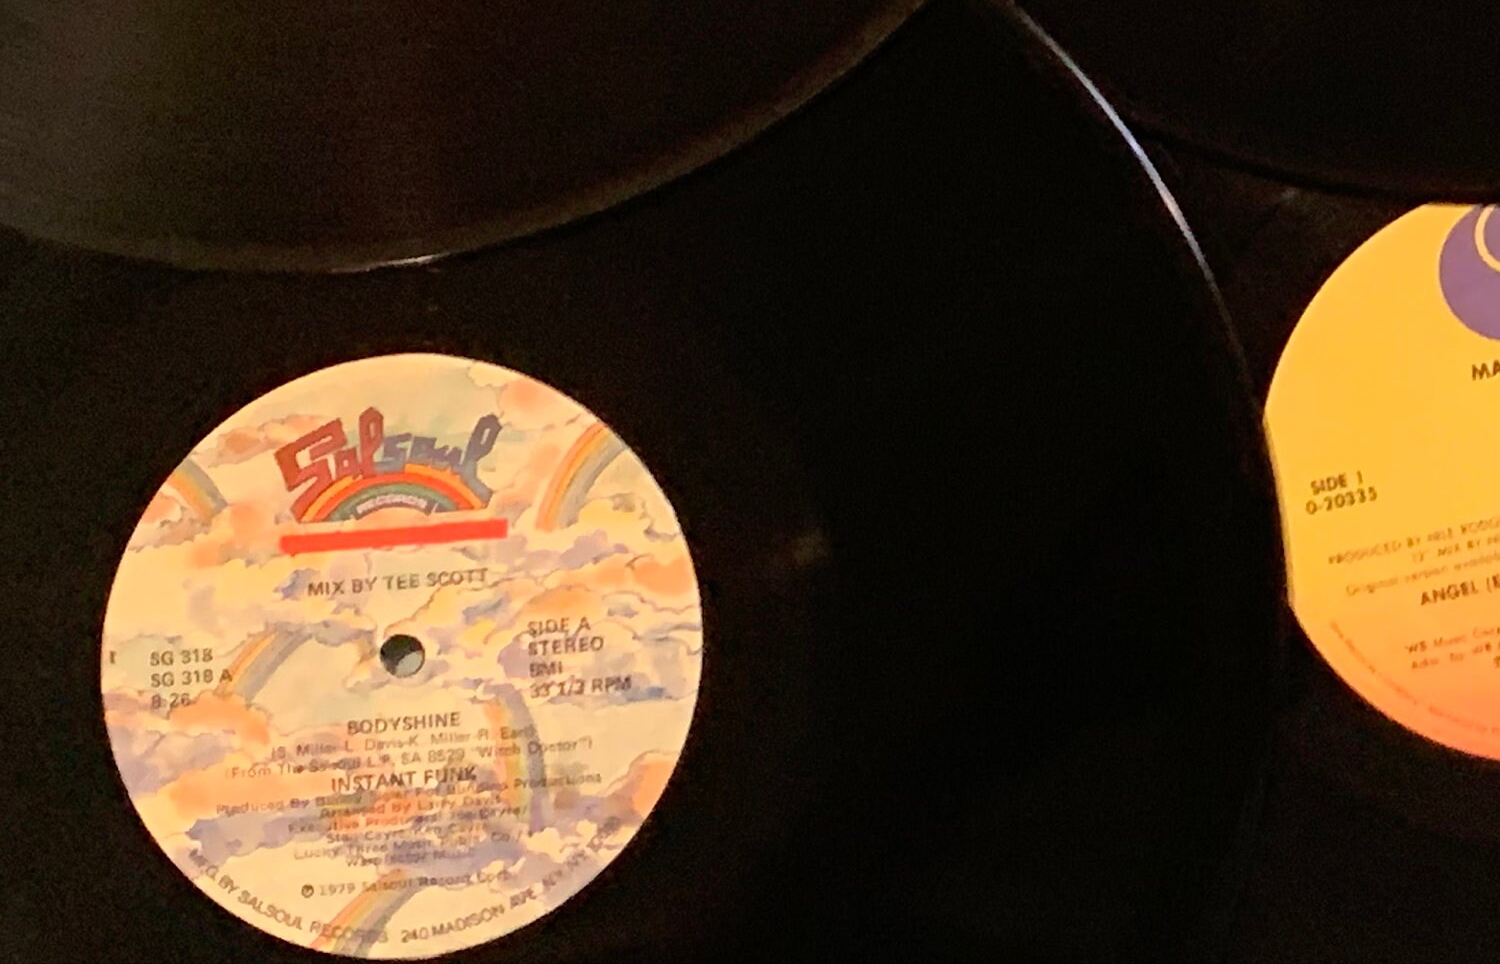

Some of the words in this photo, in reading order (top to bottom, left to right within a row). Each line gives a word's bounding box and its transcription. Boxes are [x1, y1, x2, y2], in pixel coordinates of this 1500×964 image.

[274, 407, 502, 522] Salsoul
[1311, 472, 1347, 495] SIDE
[1357, 470, 1364, 485] 1
[307, 580, 345, 597] MIX
[354, 577, 377, 594] BY
[386, 574, 421, 591] TEE
[427, 568, 488, 587] SCOTT
[1420, 580, 1479, 606] ANGEL
[528, 619, 570, 637] SIDE
[576, 616, 591, 633] A
[150, 651, 174, 667] SG
[181, 648, 213, 664] 318
[528, 637, 604, 656] STEREO
[150, 672, 174, 688] SG
[181, 669, 214, 685] 318
[219, 669, 234, 683] A
[530, 681, 554, 698] 33
[590, 675, 632, 694] RPM
[346, 711, 461, 735] BODYSHINE
[331, 769, 416, 792] INSTANT
[423, 766, 477, 784] FUNK
[238, 890, 302, 930] SALSOUL
[431, 906, 505, 936] MADISON
